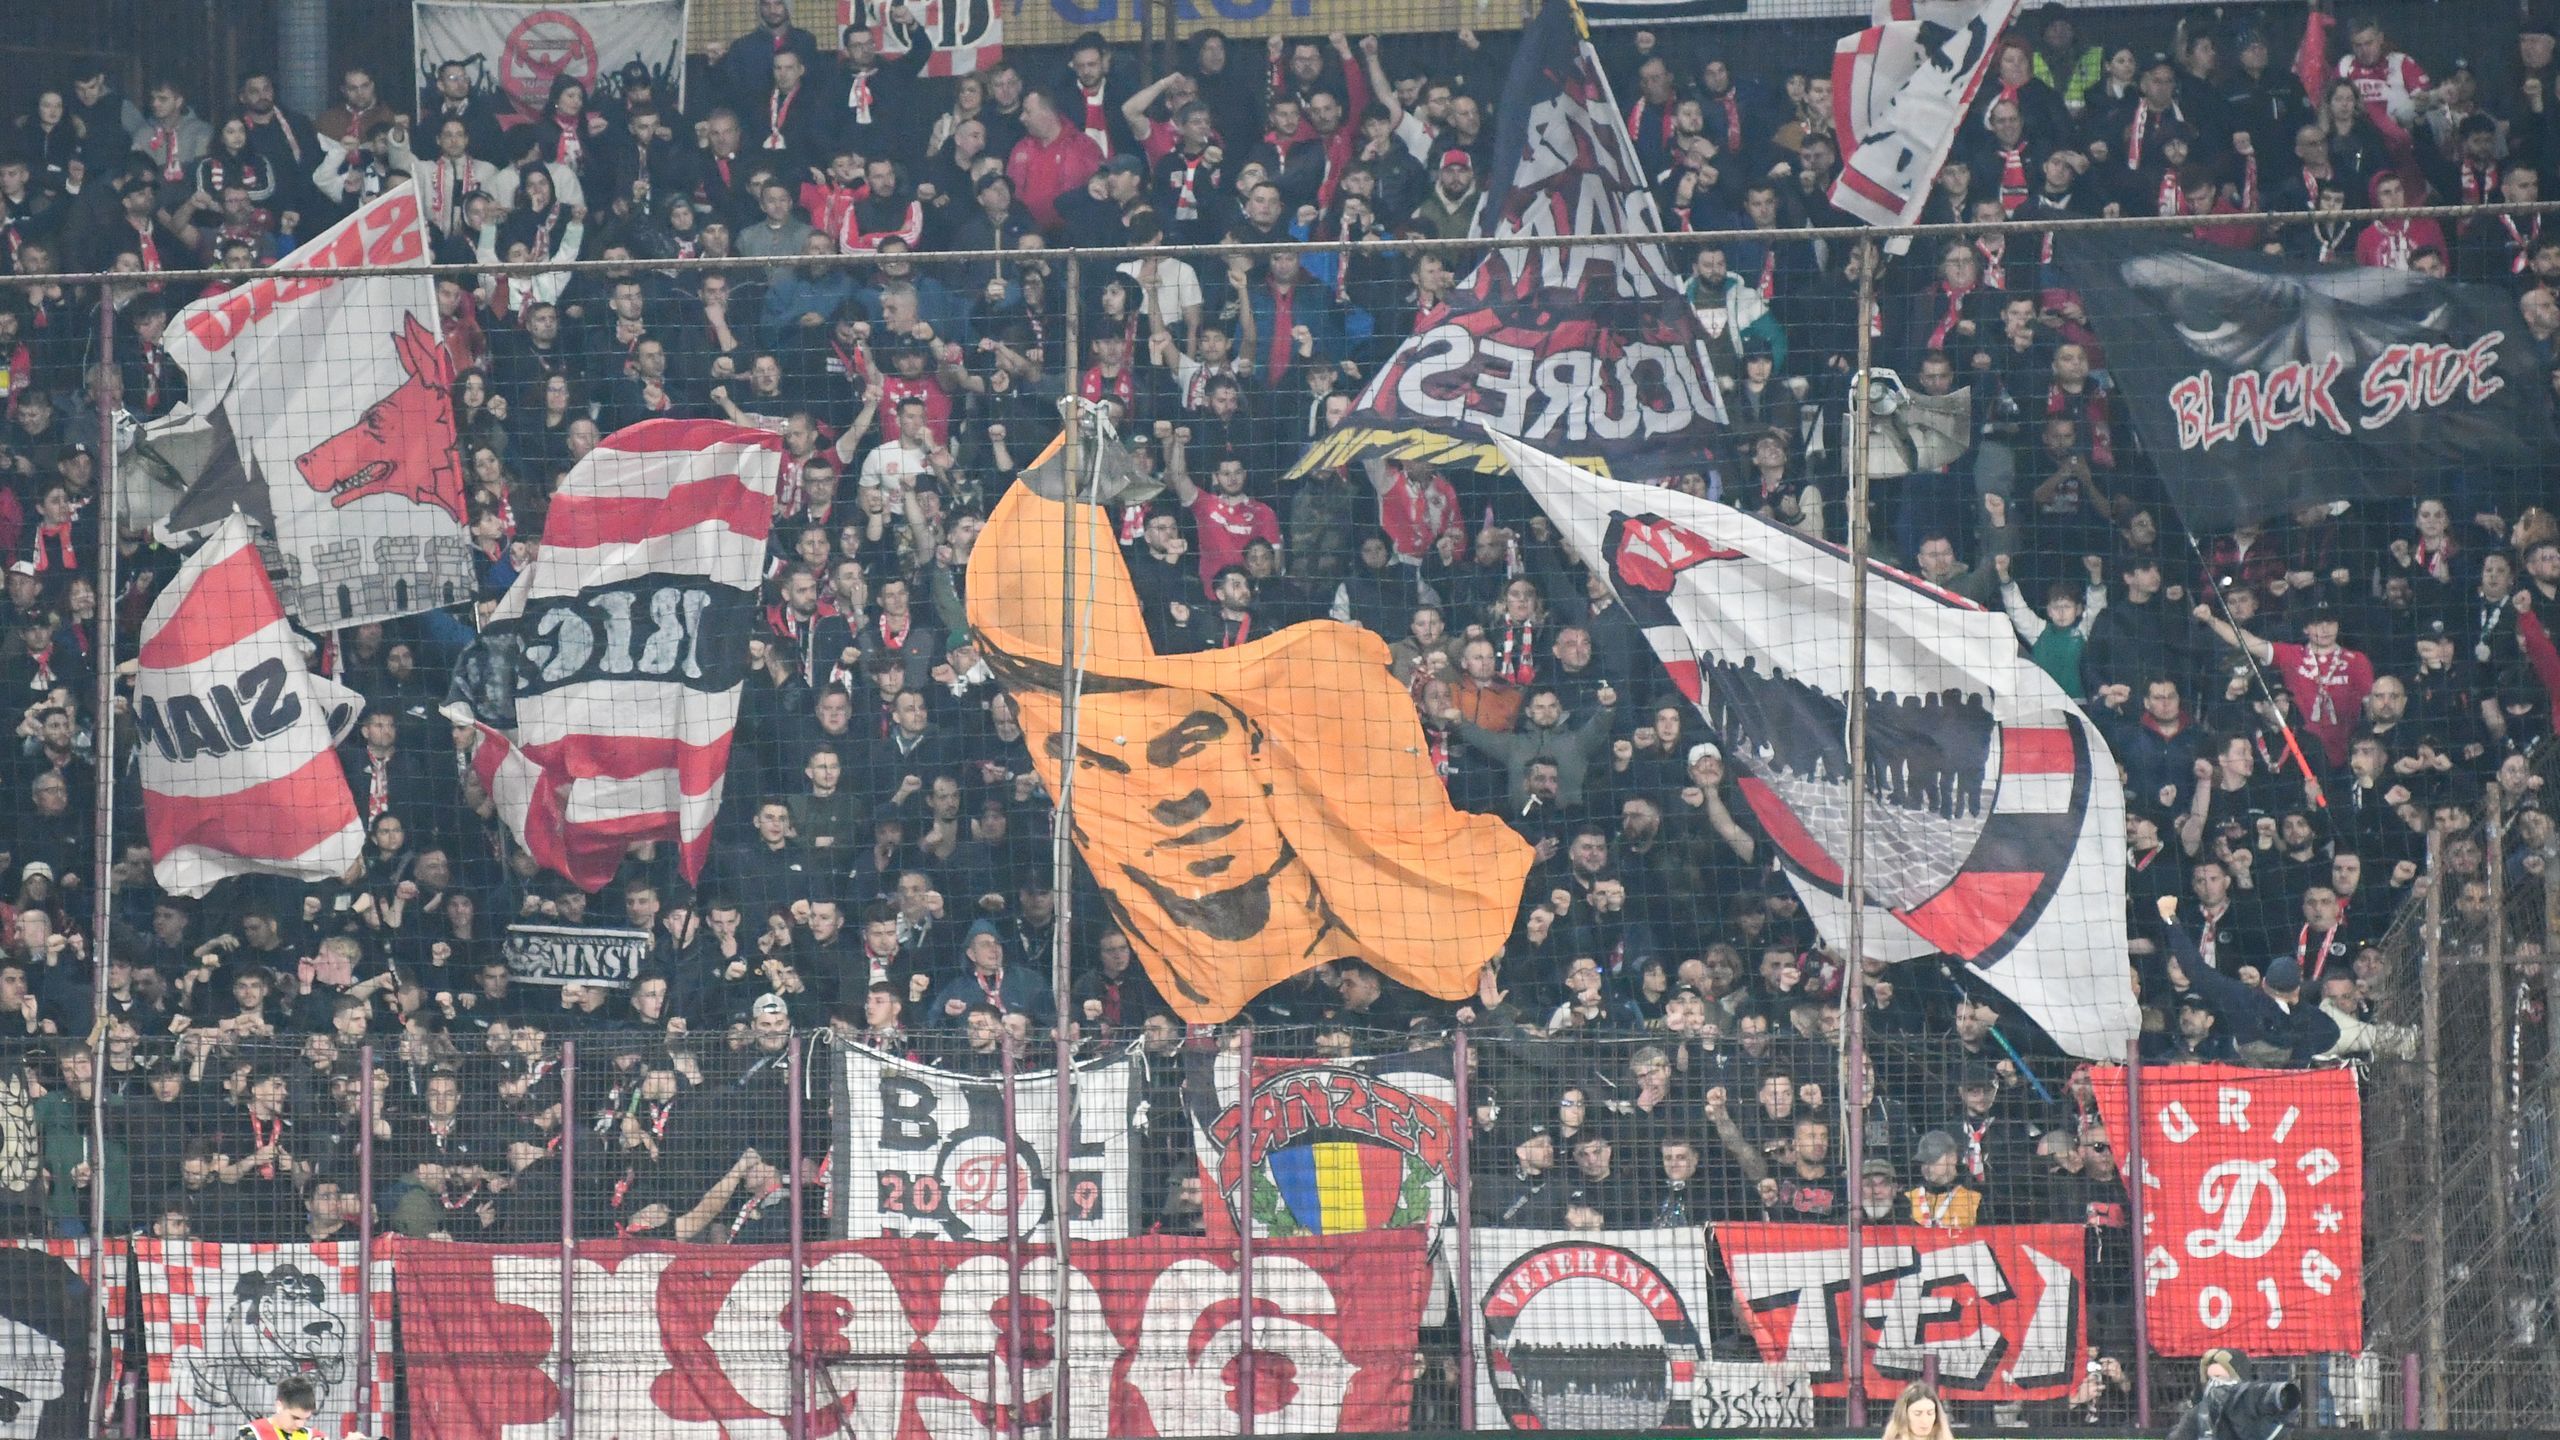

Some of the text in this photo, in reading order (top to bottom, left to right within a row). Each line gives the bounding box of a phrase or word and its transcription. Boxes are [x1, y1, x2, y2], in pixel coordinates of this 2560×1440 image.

[2169, 330, 2506, 451] BLACK SIDE
[1496, 1247, 1670, 1308] VETERANII
